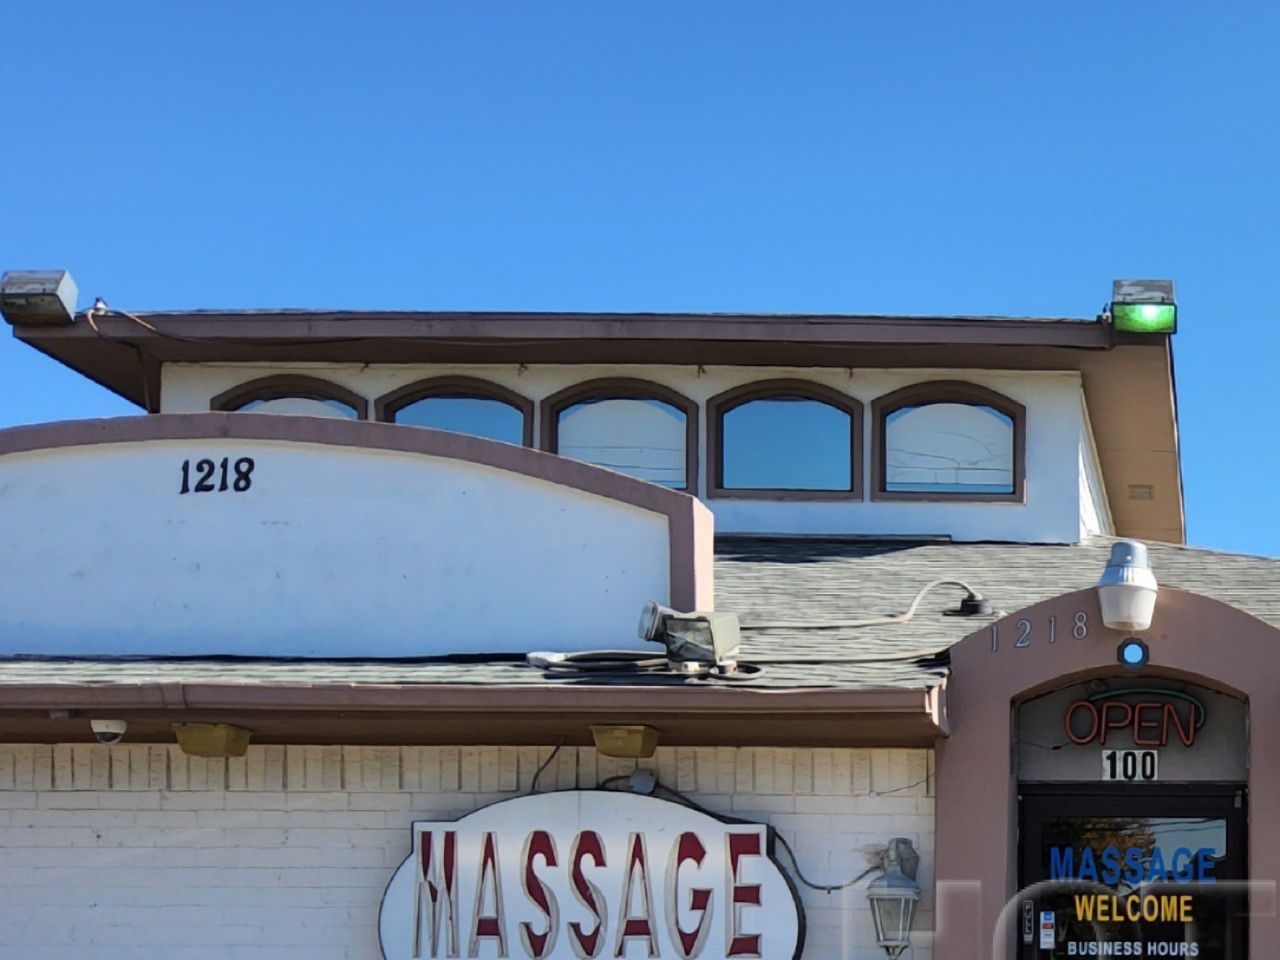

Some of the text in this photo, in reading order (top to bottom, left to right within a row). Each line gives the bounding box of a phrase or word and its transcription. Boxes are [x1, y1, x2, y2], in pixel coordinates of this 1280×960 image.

[180, 457, 255, 494] 1218
[990, 612, 1088, 652] 1218
[1065, 700, 1196, 746] OPEN
[1105, 751, 1156, 780] 100
[1050, 847, 1217, 885] MASSAGE
[411, 829, 763, 960] MASSAGE
[1075, 895, 1193, 922] WELCOME
[1067, 941, 1199, 957] BUSINESS HOURS
